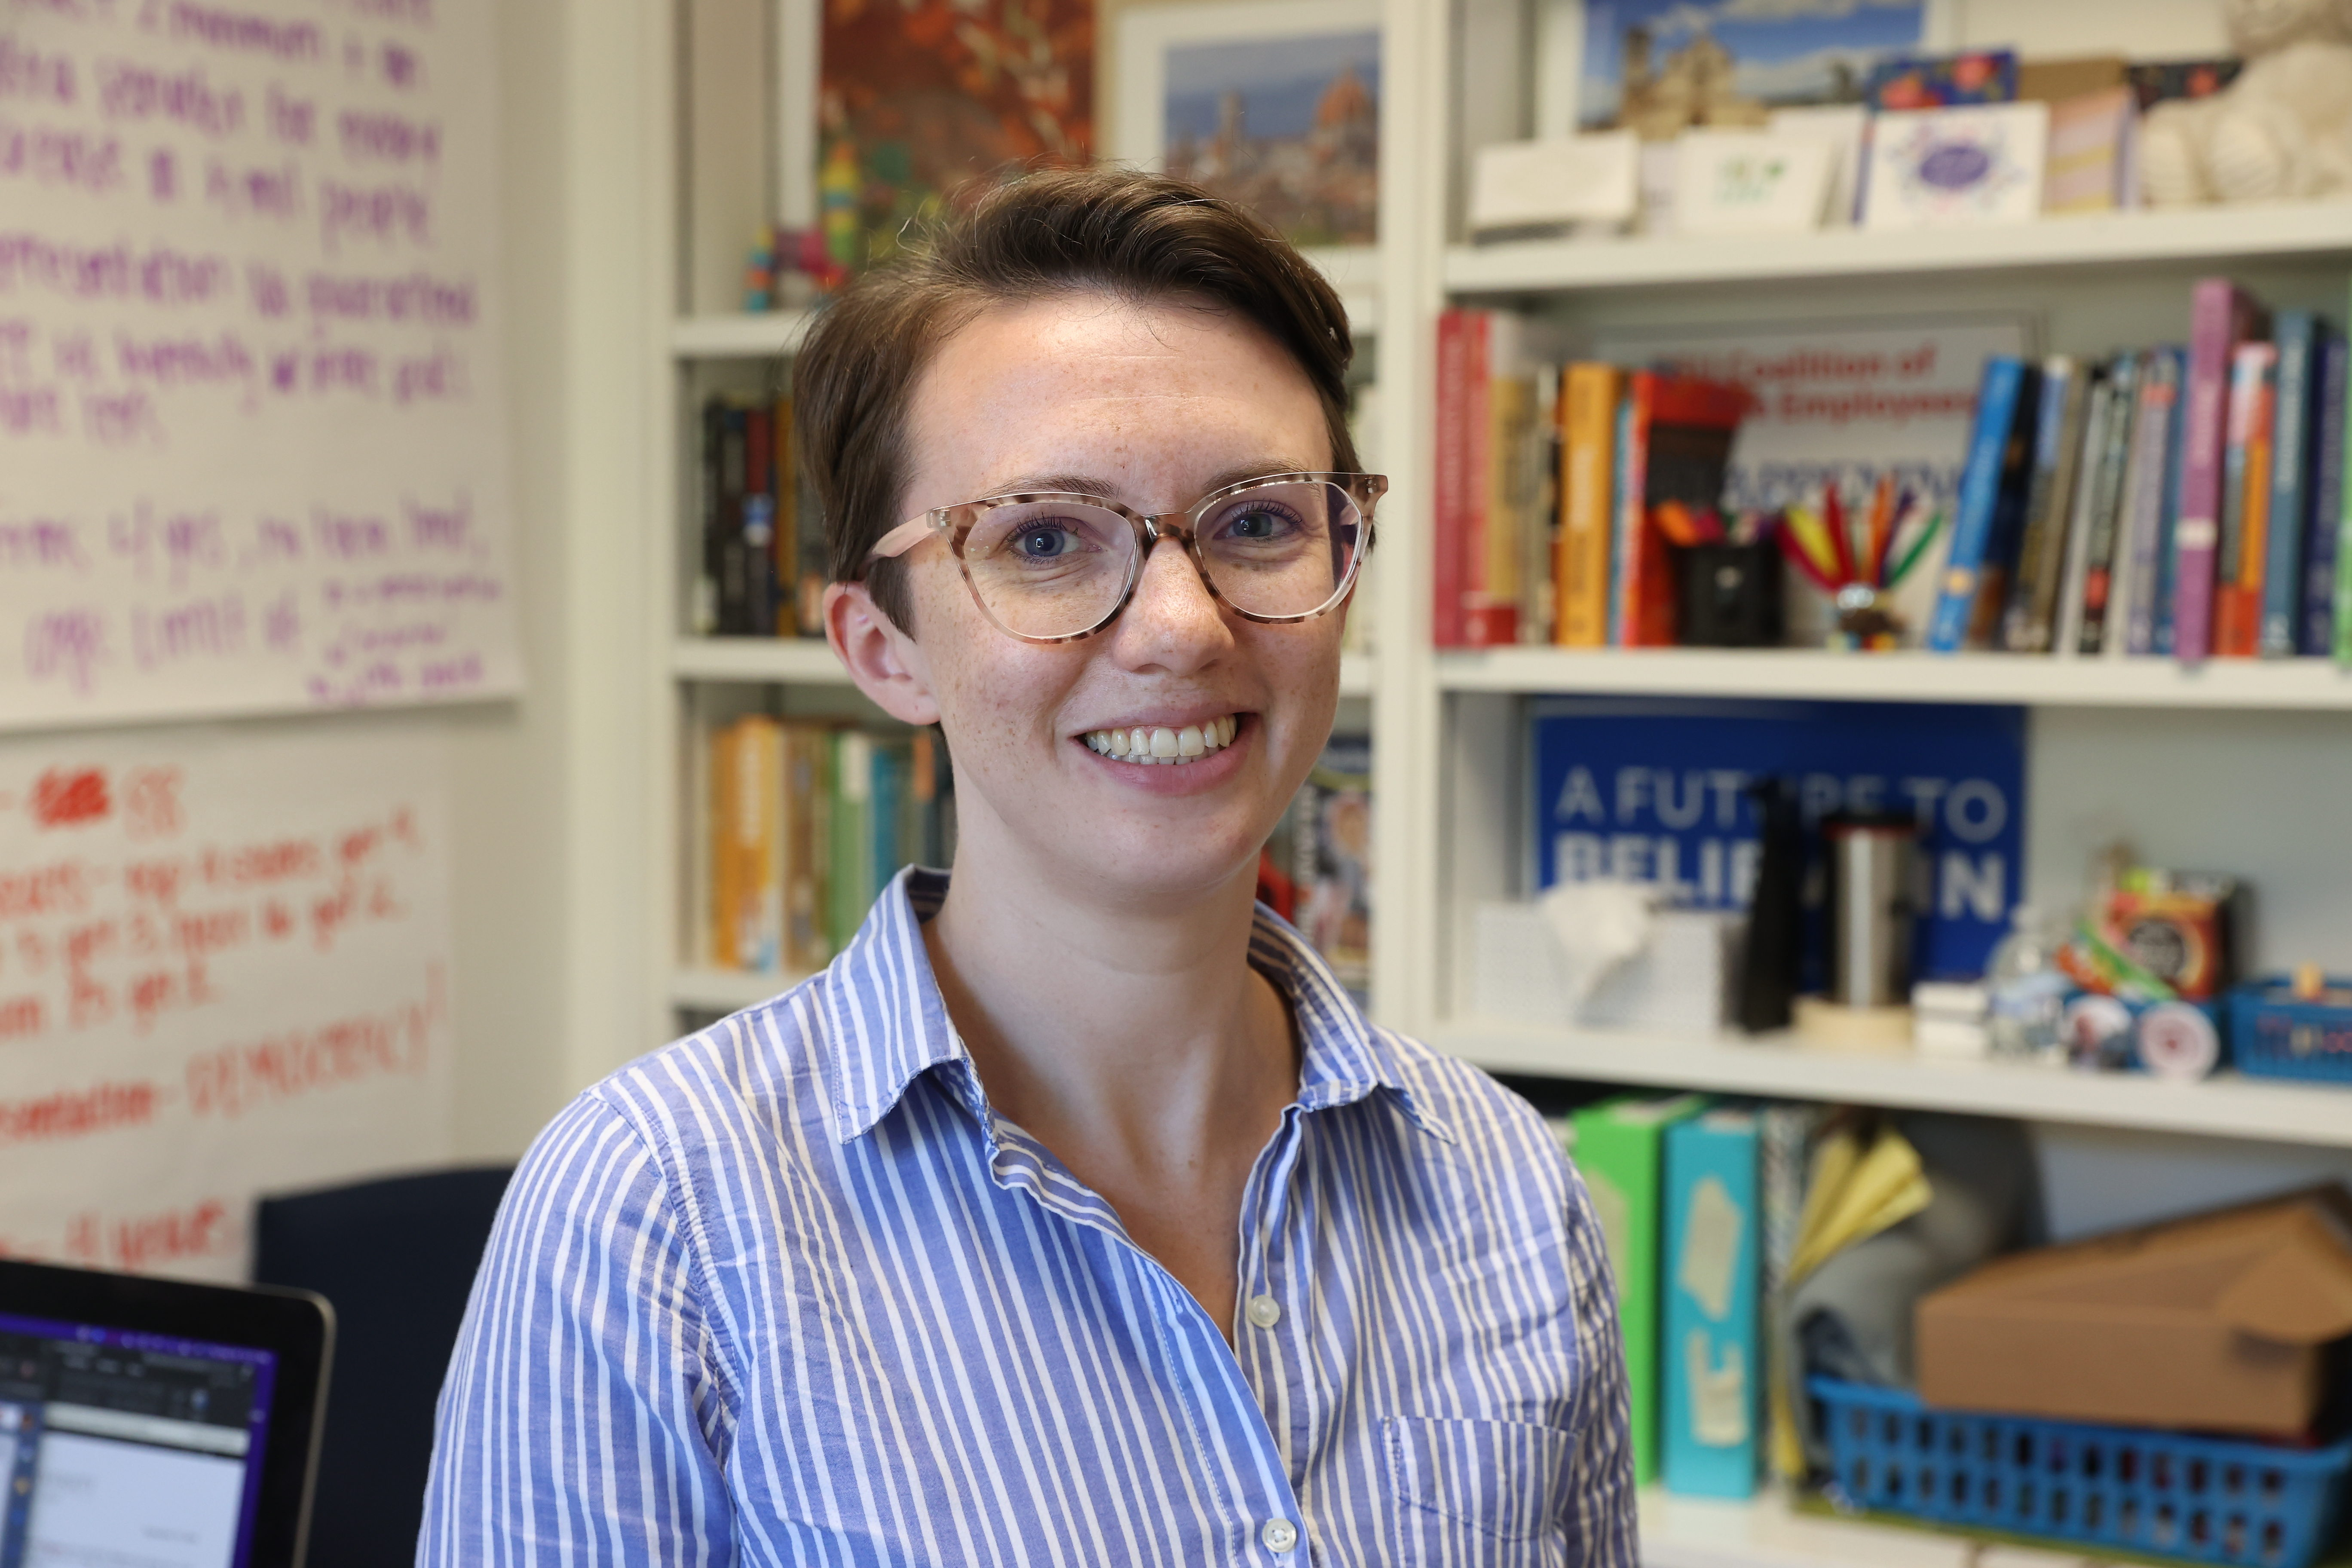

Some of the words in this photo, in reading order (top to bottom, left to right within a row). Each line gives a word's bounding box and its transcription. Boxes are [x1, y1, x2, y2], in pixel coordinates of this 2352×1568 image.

[1553, 764, 1607, 827] A
[1612, 765, 1888, 832] FUTRE
[1899, 773, 2010, 845] TO
